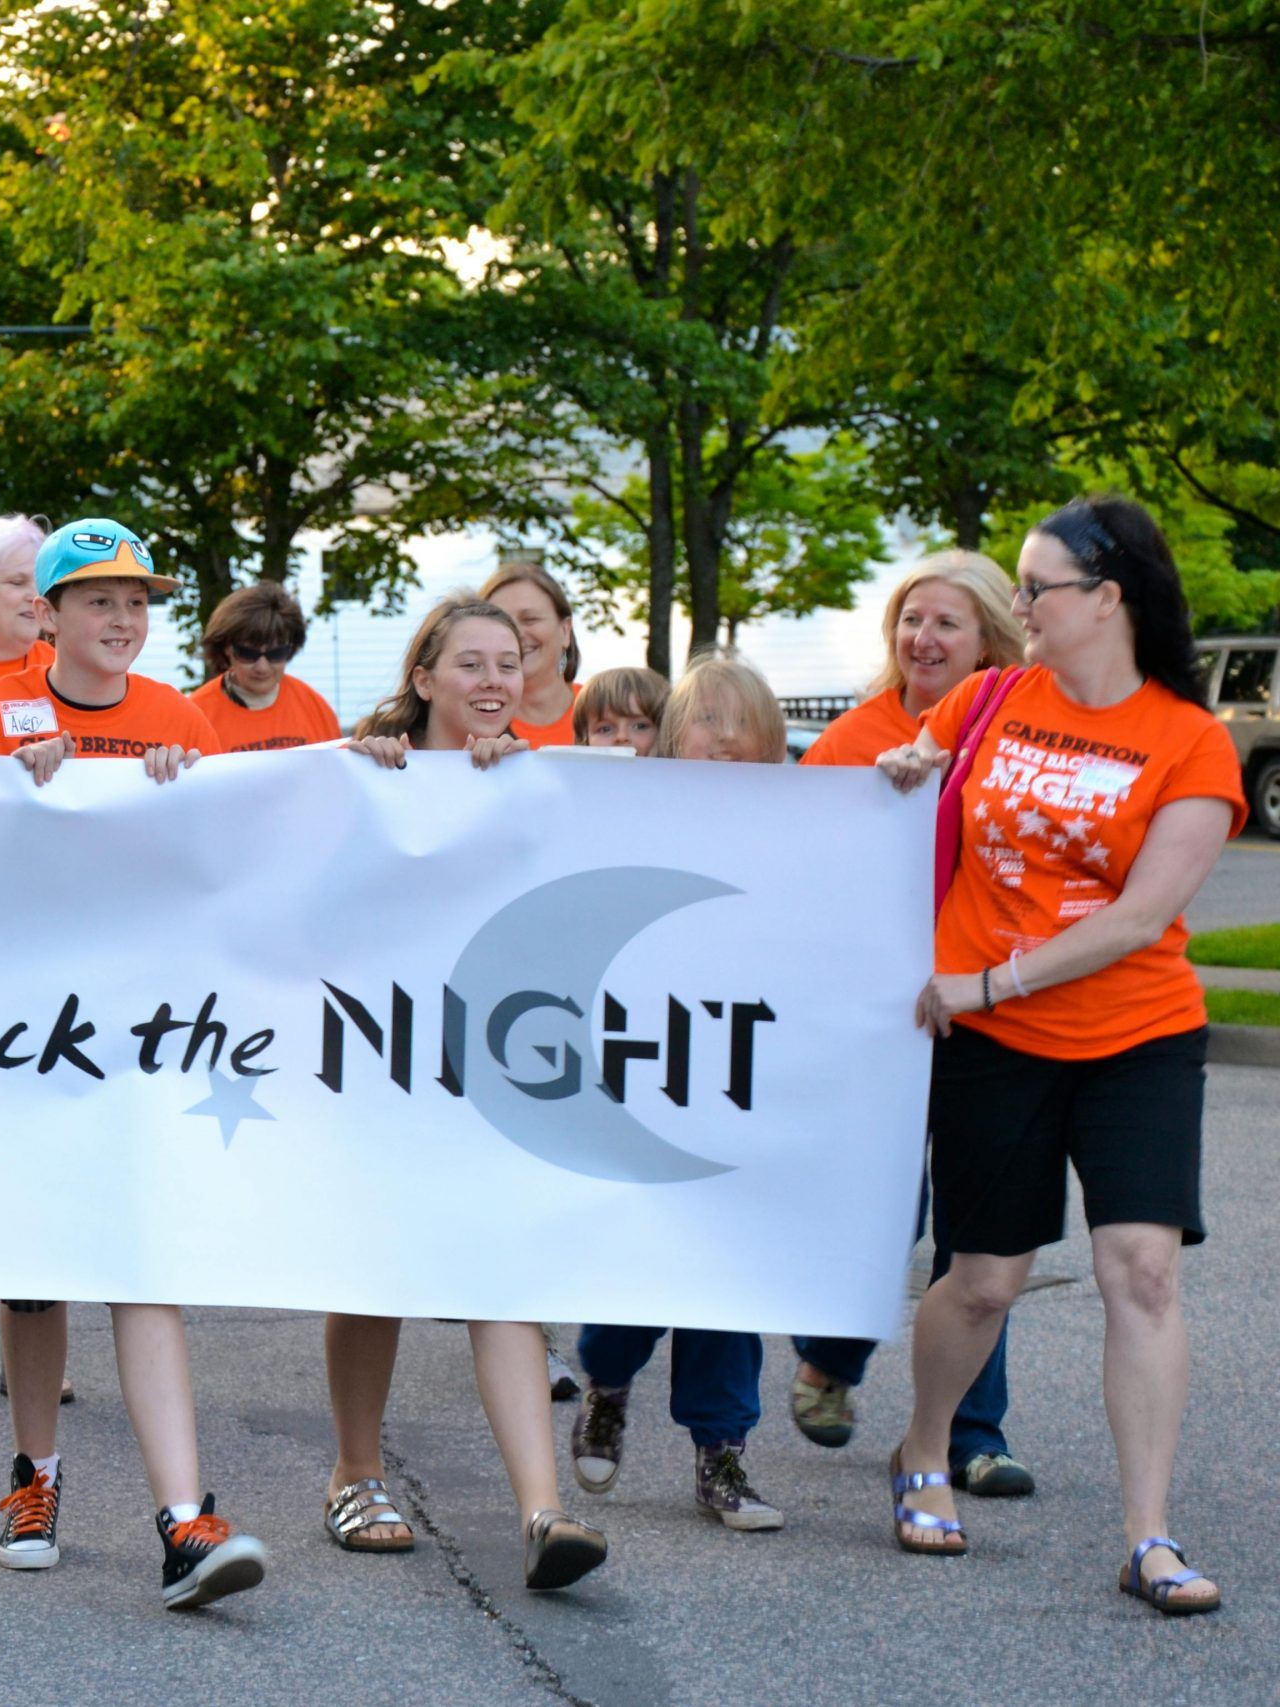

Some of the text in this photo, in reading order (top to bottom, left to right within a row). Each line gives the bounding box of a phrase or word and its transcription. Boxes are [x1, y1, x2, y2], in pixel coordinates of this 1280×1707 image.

[997, 738, 1047, 764] TAKE
[1044, 752, 1085, 773] BAC
[1003, 720, 1059, 747] CAPE
[1060, 733, 1151, 767] BRETON
[130, 991, 280, 1077] the
[313, 977, 777, 1112] NIGHT
